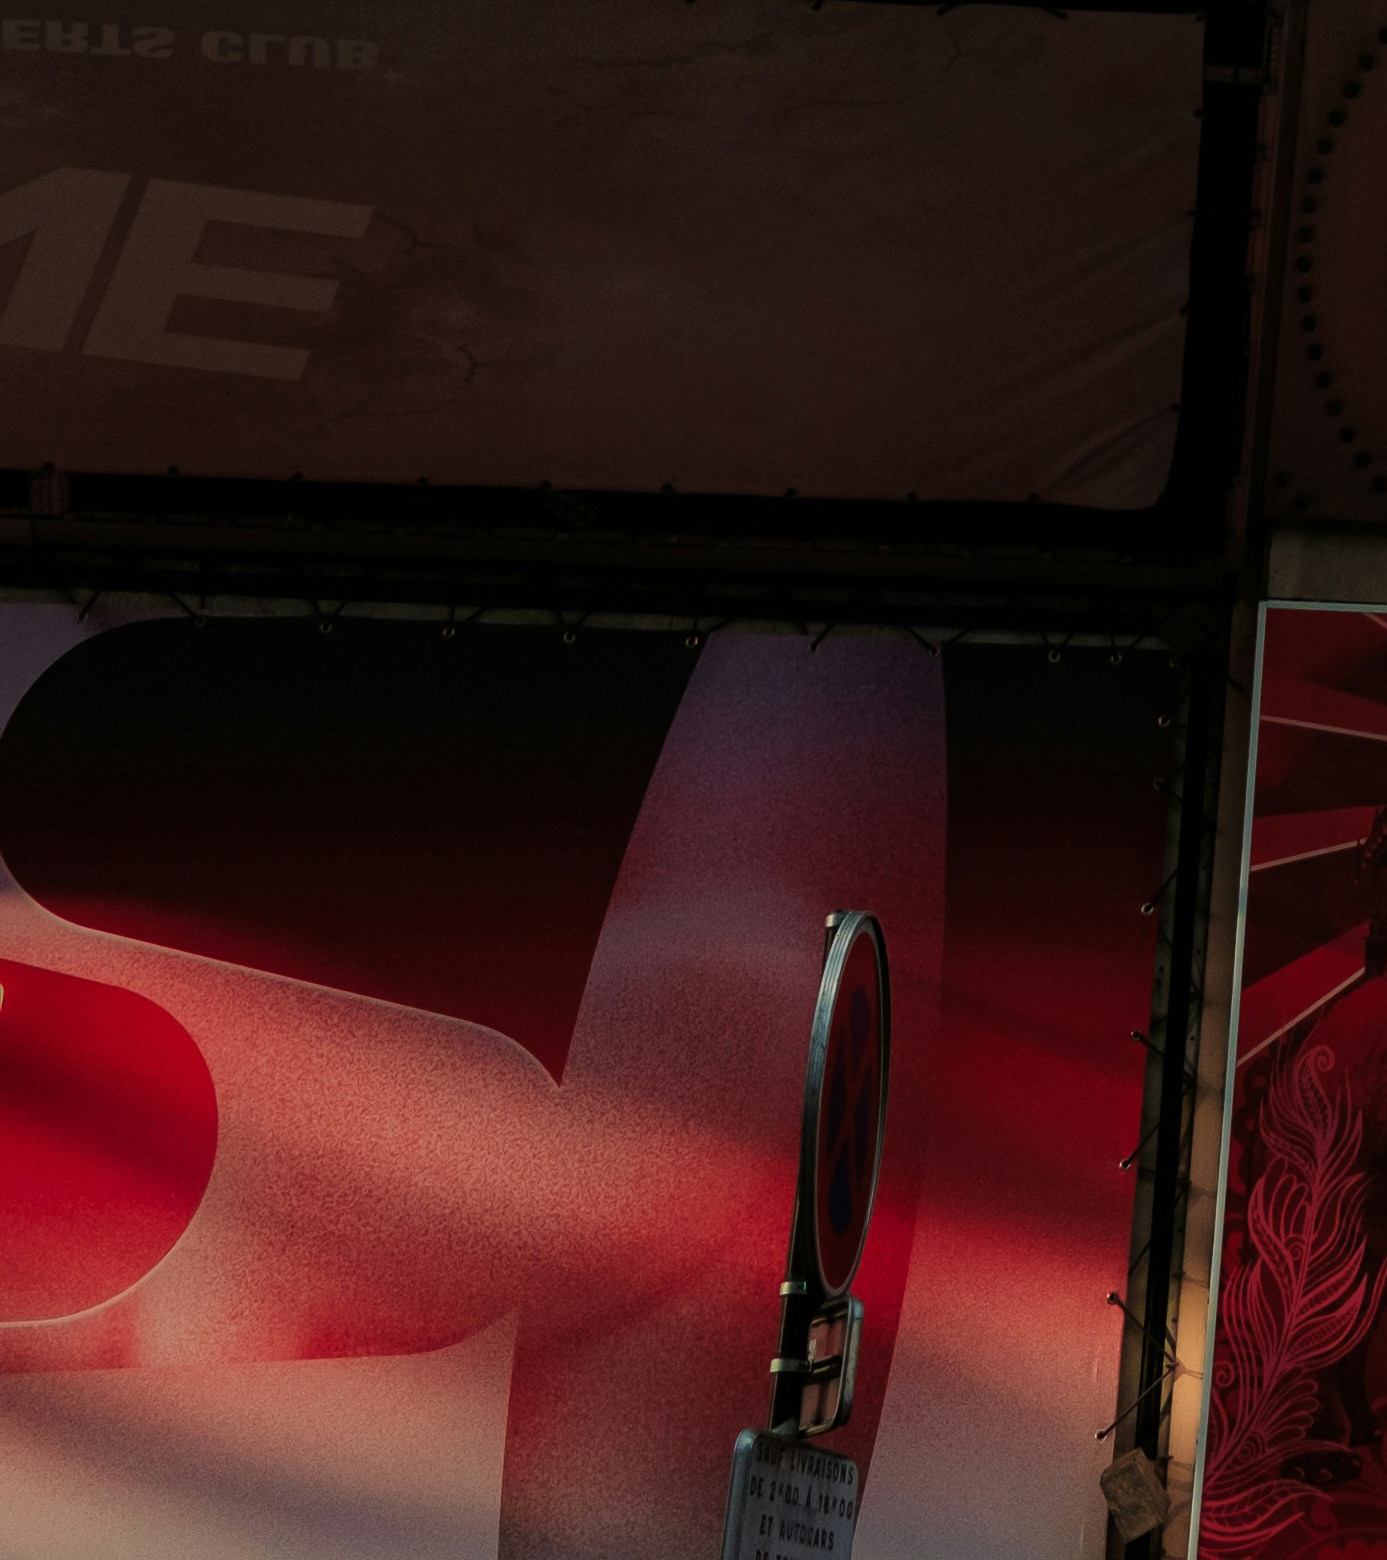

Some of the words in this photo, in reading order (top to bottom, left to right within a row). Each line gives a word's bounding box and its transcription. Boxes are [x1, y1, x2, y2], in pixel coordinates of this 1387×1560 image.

[757, 1441, 785, 1469] SAUF
[790, 1447, 854, 1486] LIVRAISONS
[750, 1475, 764, 1498] DE
[760, 1514, 774, 1537] ET
[779, 1520, 835, 1552] AUTOCARS
